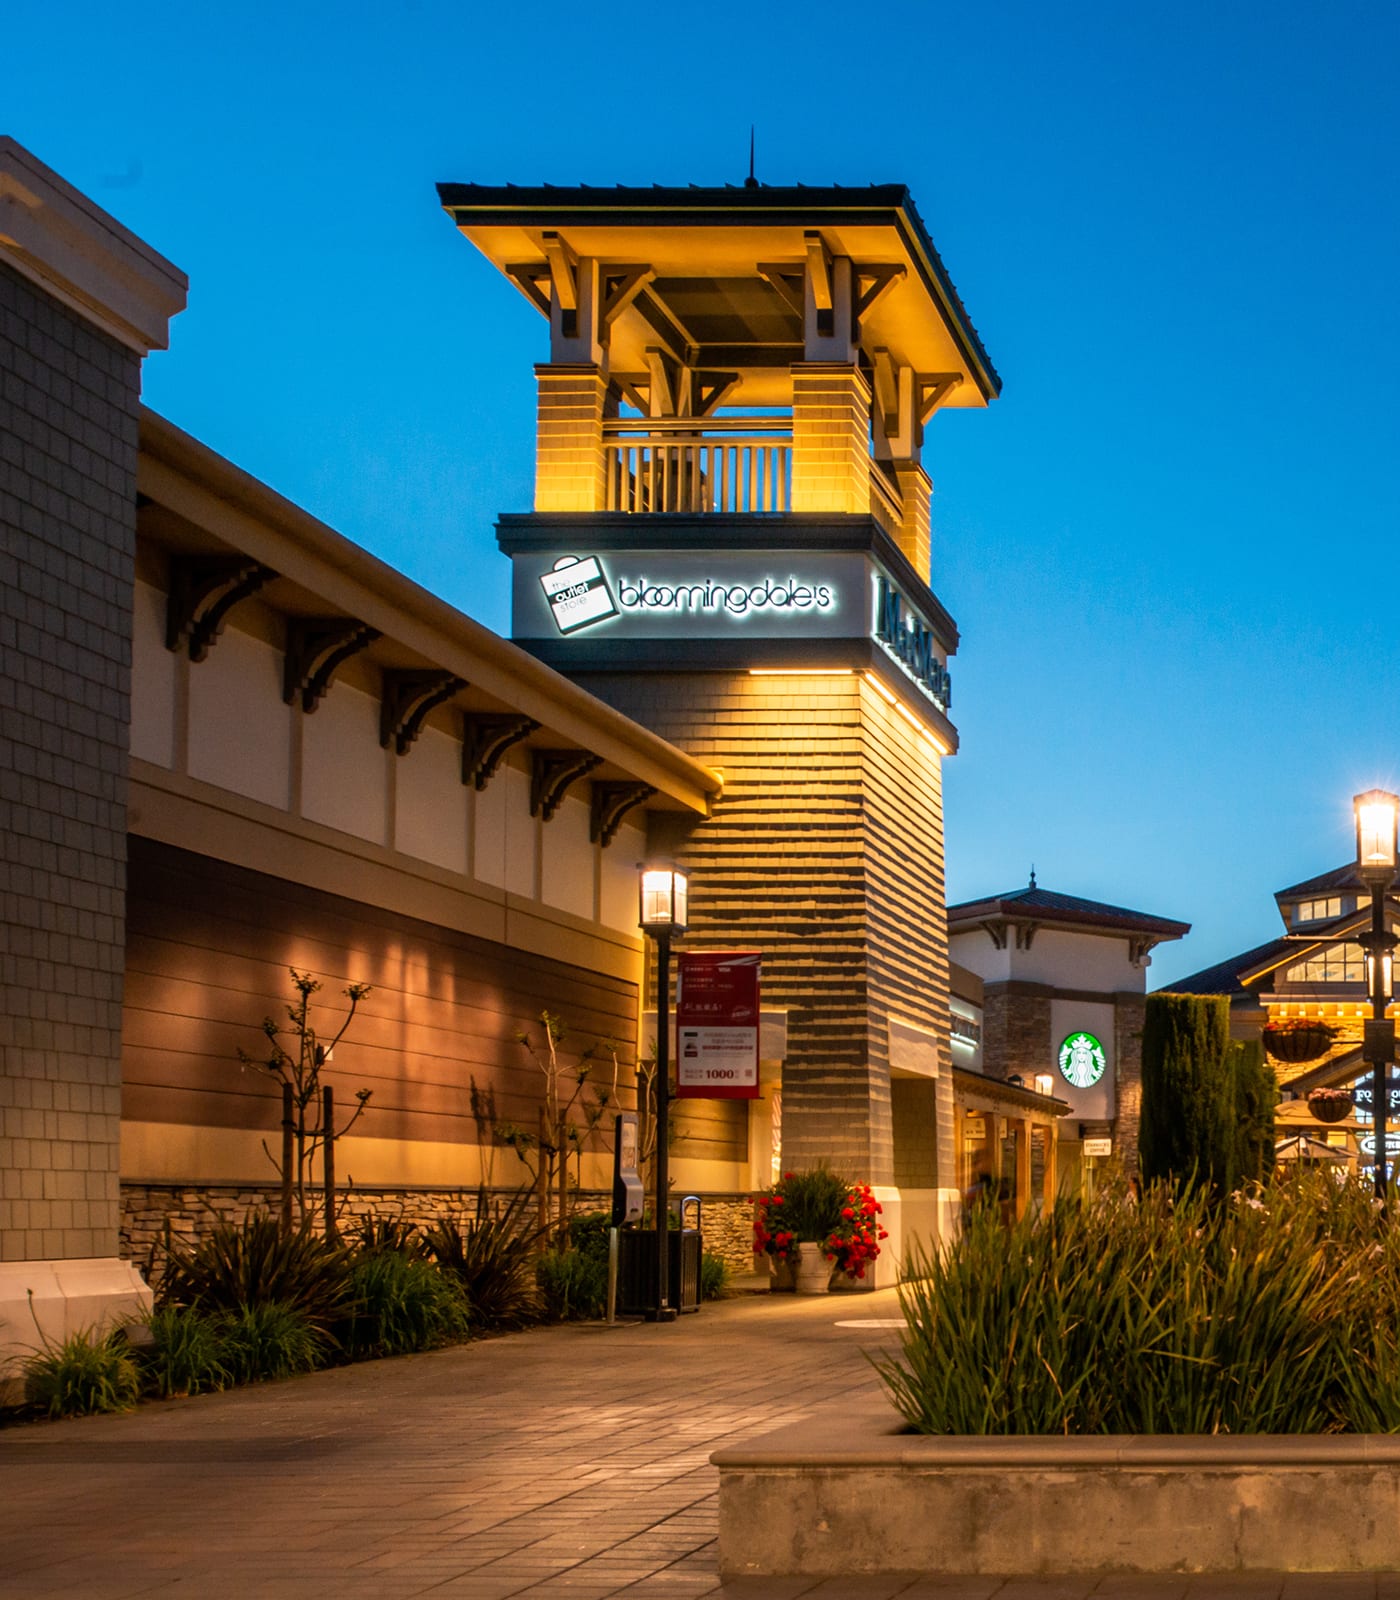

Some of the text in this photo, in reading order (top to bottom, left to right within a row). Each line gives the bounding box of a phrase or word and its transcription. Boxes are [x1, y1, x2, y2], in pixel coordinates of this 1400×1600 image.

[555, 582, 588, 602] outlet
[619, 579, 830, 613] bloomingdale's
[706, 1069, 734, 1079] 1000
